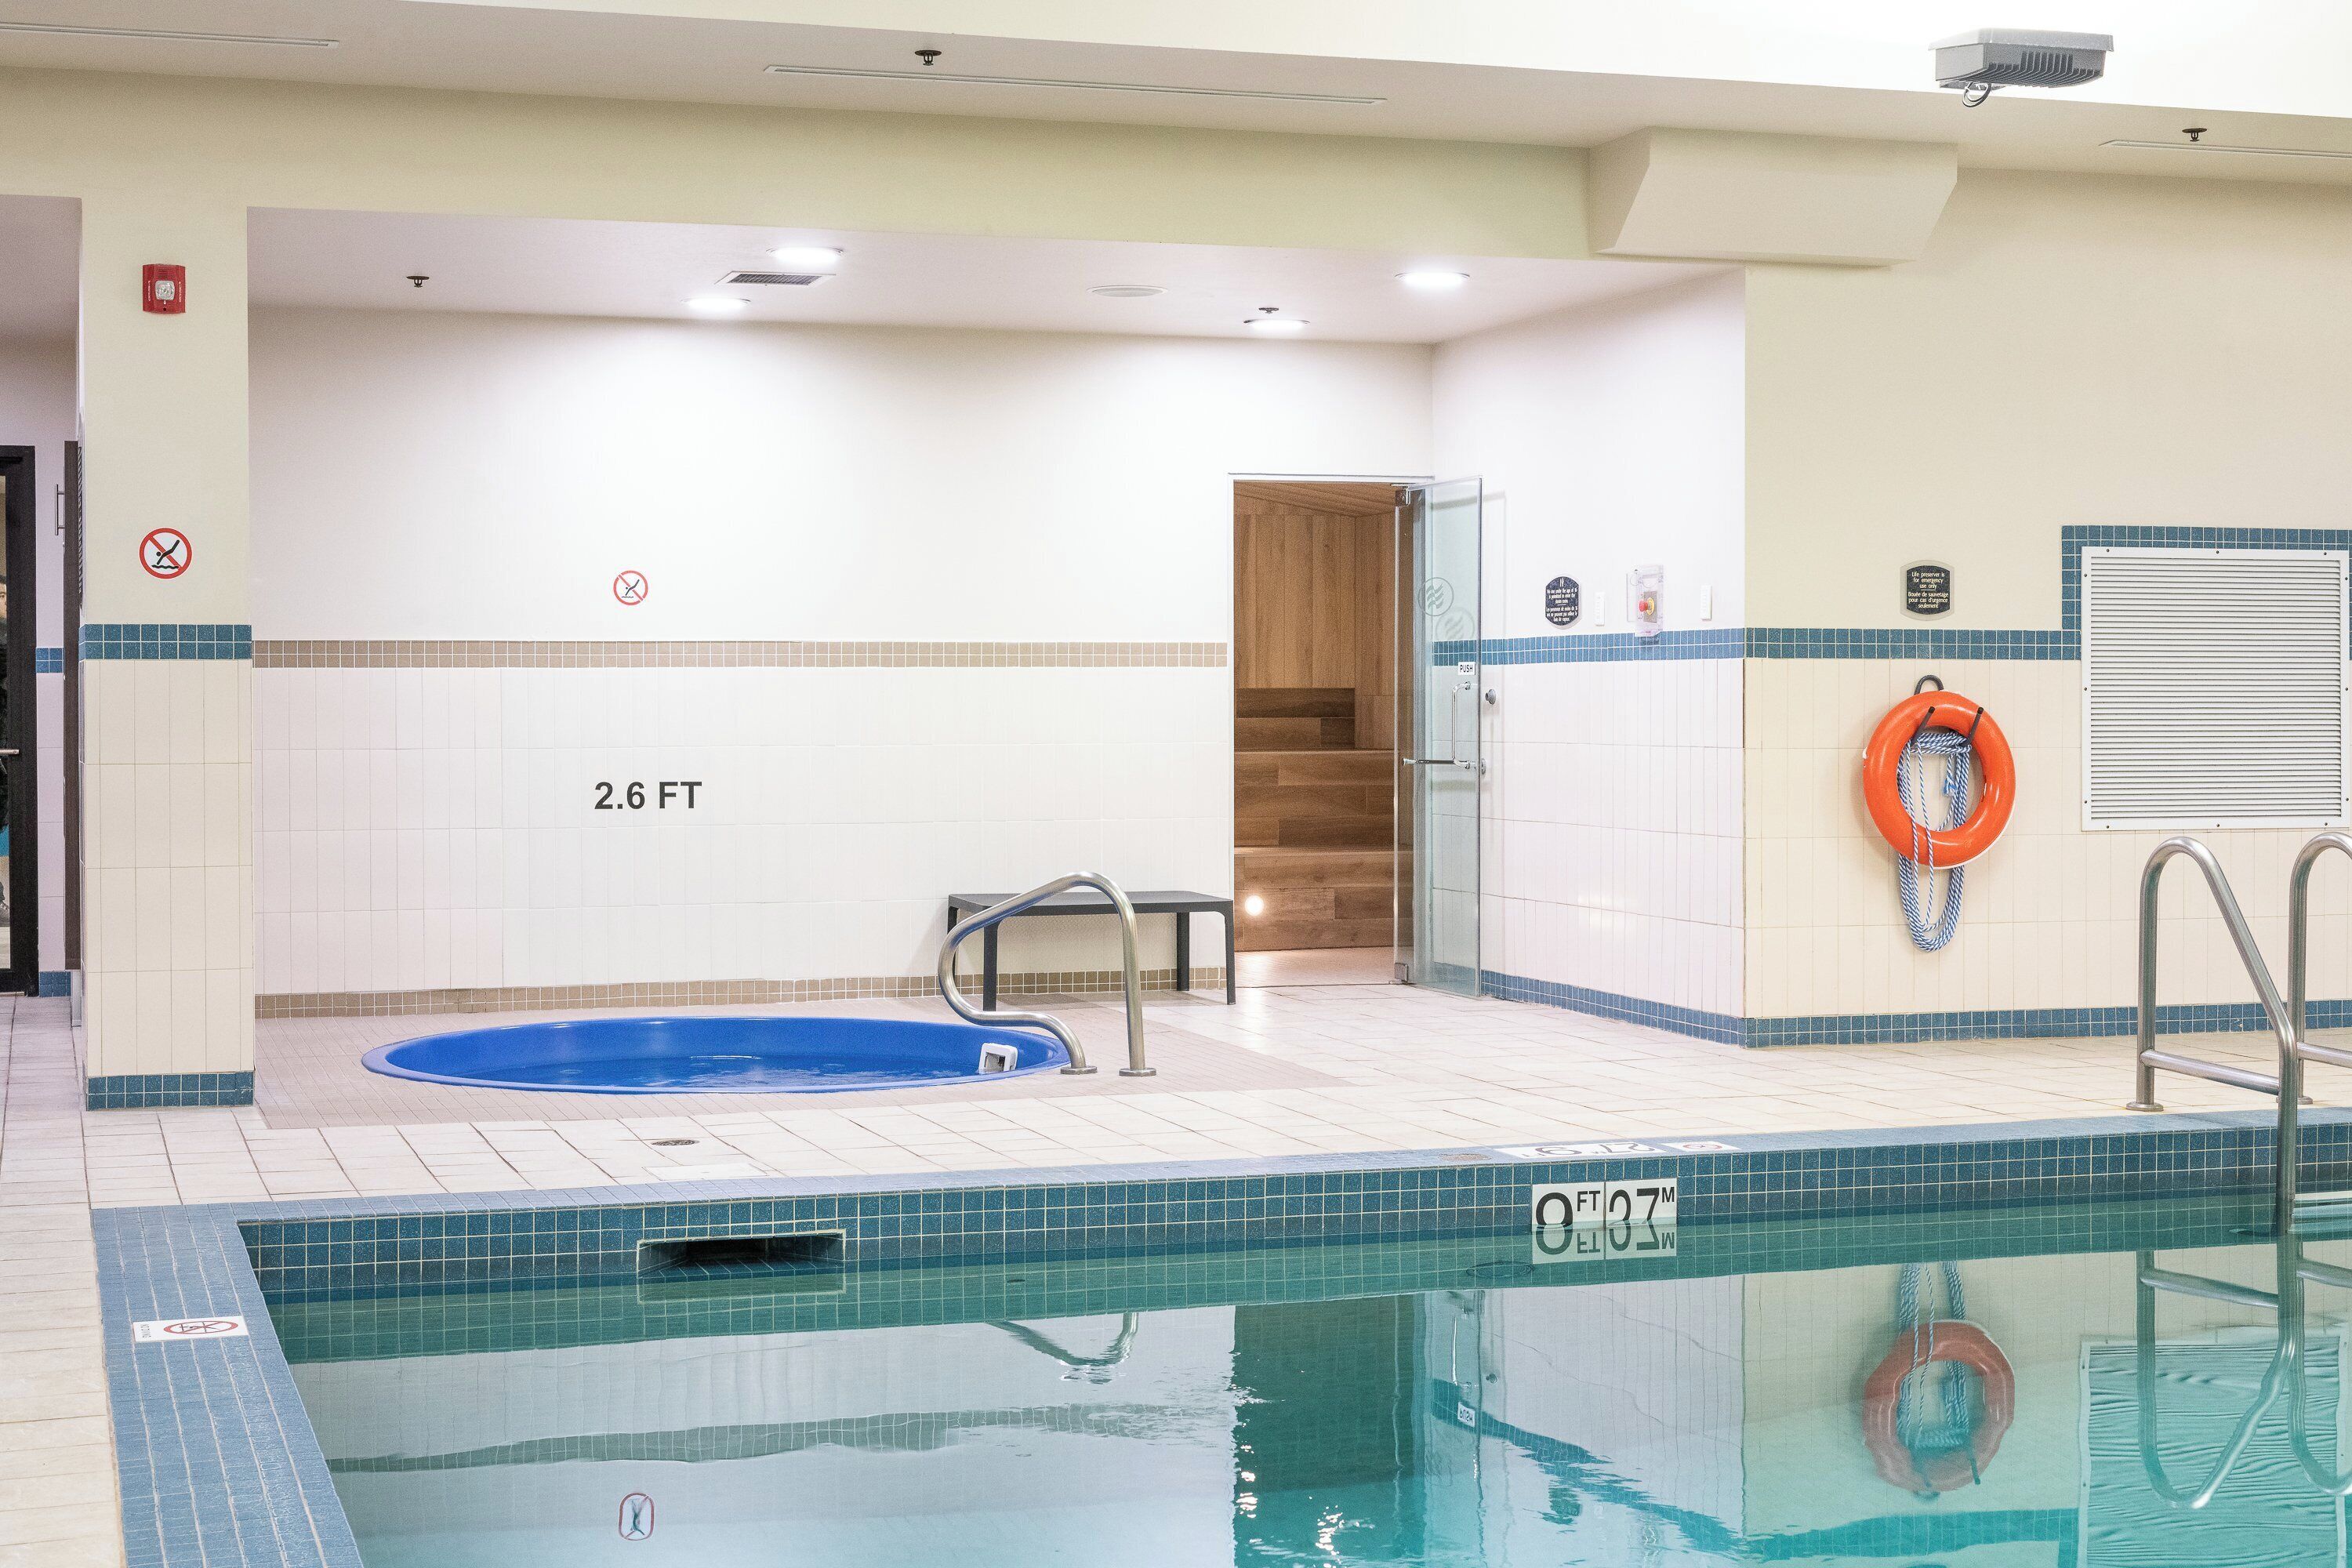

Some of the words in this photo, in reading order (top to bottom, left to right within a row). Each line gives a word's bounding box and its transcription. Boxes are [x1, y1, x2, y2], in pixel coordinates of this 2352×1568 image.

[594, 782, 645, 809] 2.6
[659, 782, 702, 809] FT
[1577, 1190, 1601, 1211] FT
[1662, 1187, 1675, 1203] M
